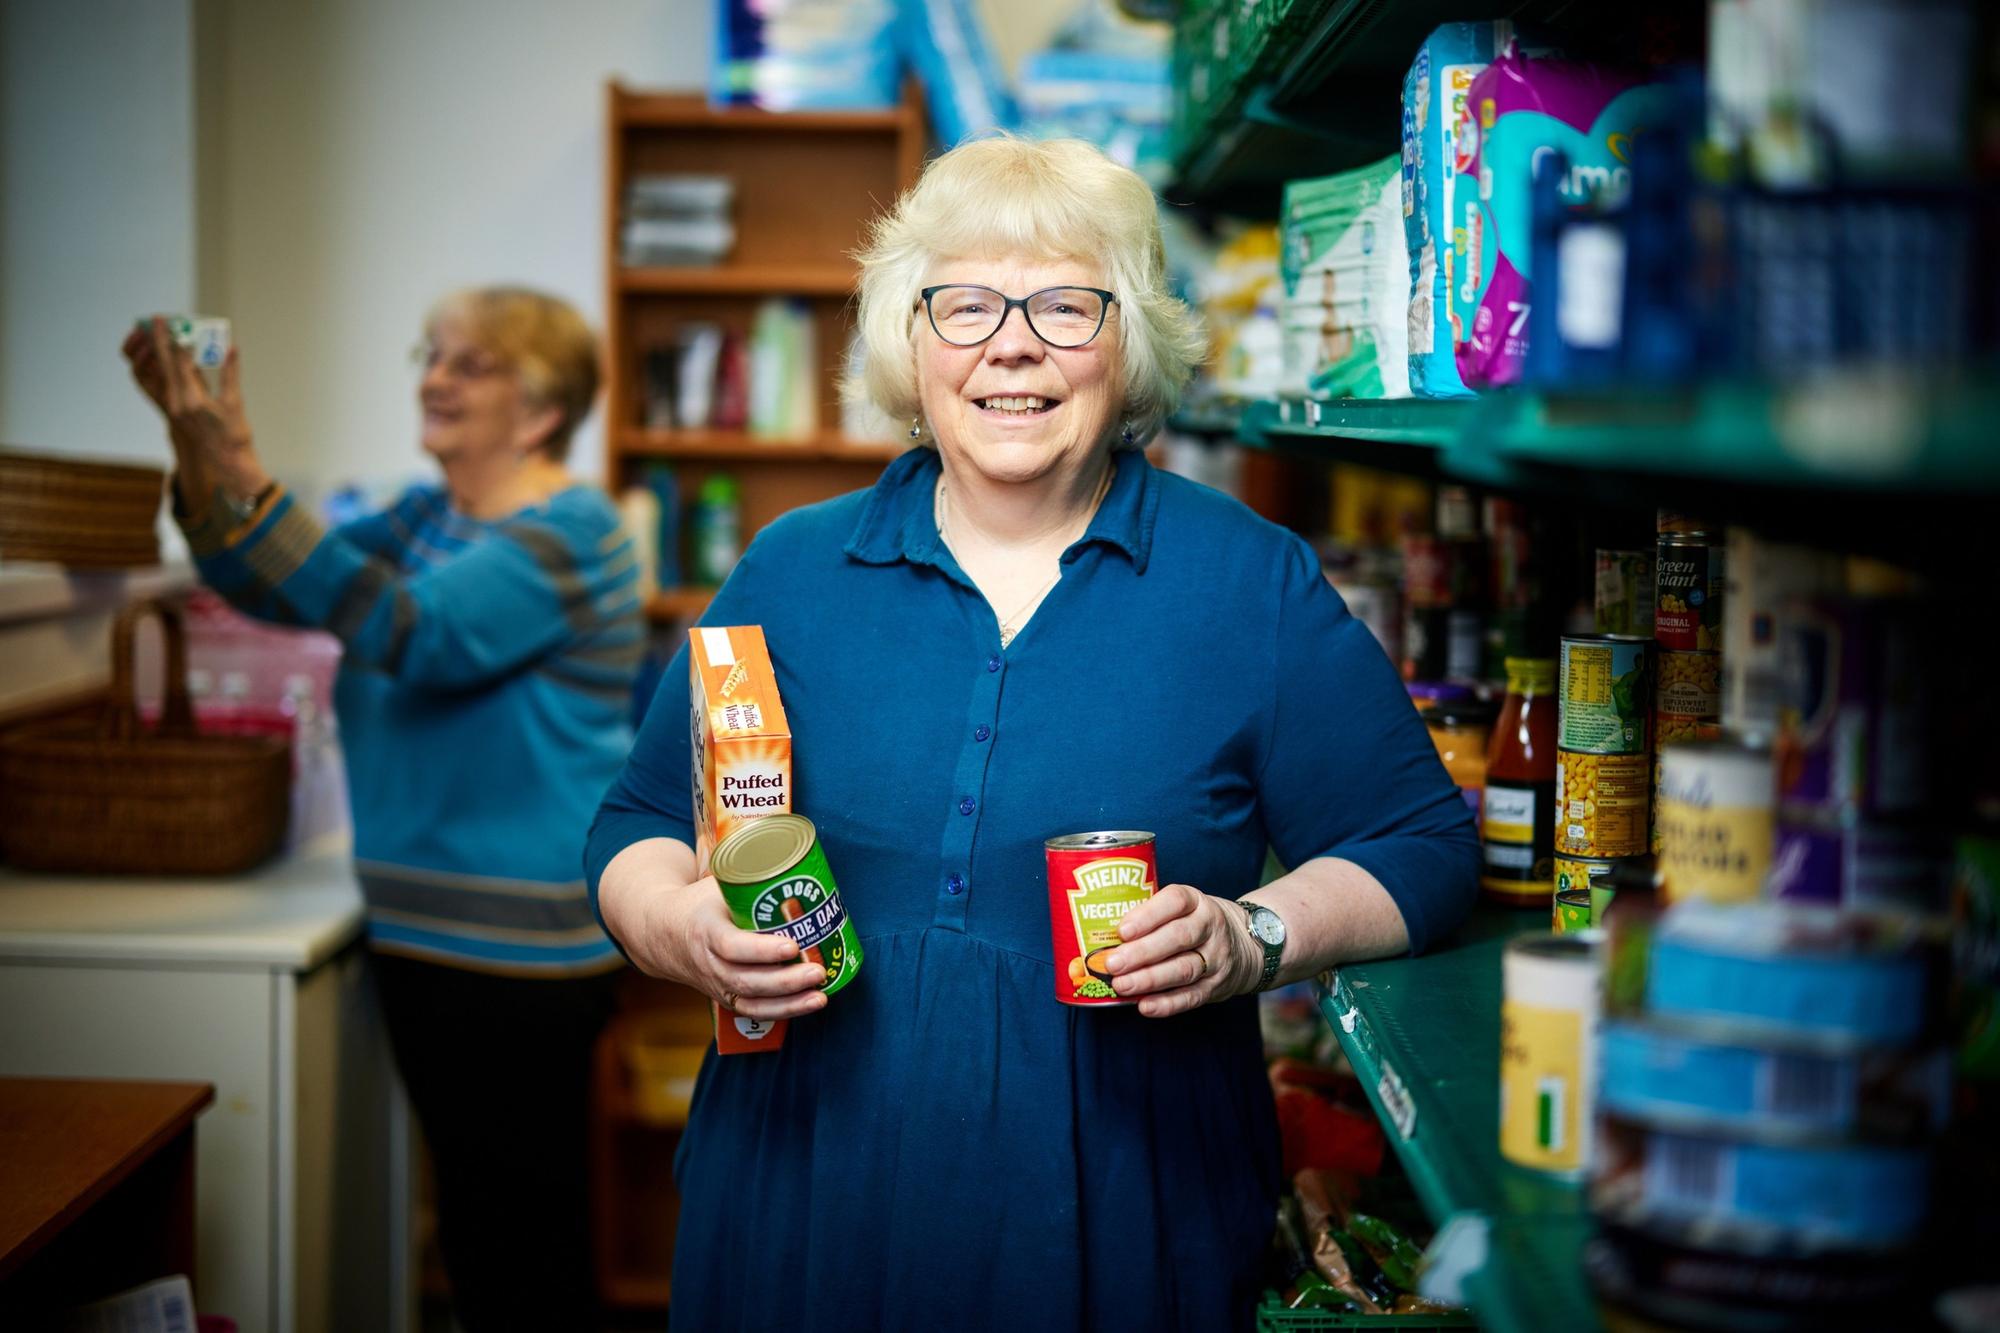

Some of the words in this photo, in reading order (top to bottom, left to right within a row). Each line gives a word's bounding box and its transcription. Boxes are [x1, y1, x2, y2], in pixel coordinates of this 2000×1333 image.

[1507, 301, 1531, 337] 7
[1656, 557, 1695, 573] Green
[1657, 571, 1697, 587] Giant
[725, 704, 740, 730] Wheat
[742, 704, 760, 728] Puffed
[1663, 705, 1706, 713] SWEETCORN
[723, 773, 783, 790] Puffed
[720, 792, 785, 808] Wheat
[1085, 867, 1141, 891] HEINZ
[757, 893, 779, 922] HOT
[782, 881, 820, 902] DOGS
[816, 895, 840, 928] OAK
[1080, 898, 1149, 919] VEGETAB
